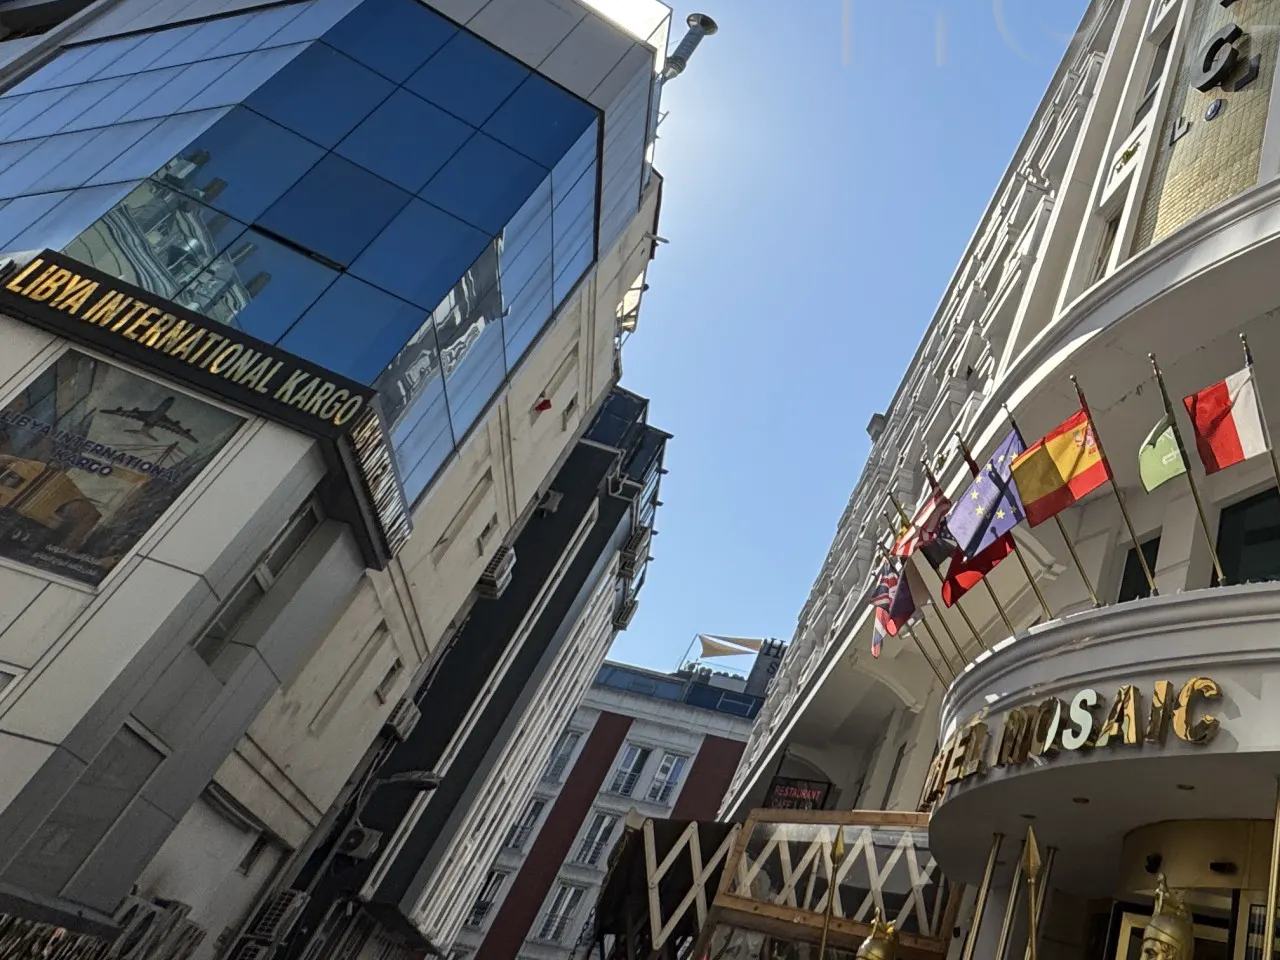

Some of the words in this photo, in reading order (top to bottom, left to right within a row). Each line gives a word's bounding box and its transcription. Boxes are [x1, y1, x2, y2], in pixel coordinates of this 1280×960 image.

[5, 258, 100, 315] LIBYA
[81, 290, 284, 393] INTERNATIONAL
[273, 369, 363, 426] KARGO
[1, 410, 52, 436] LIBYA
[56, 429, 182, 484] INTERNATIONAL
[53, 449, 113, 477] KARGO
[992, 676, 1223, 767] MOSAIC
[774, 784, 822, 801] RESTAURANT
